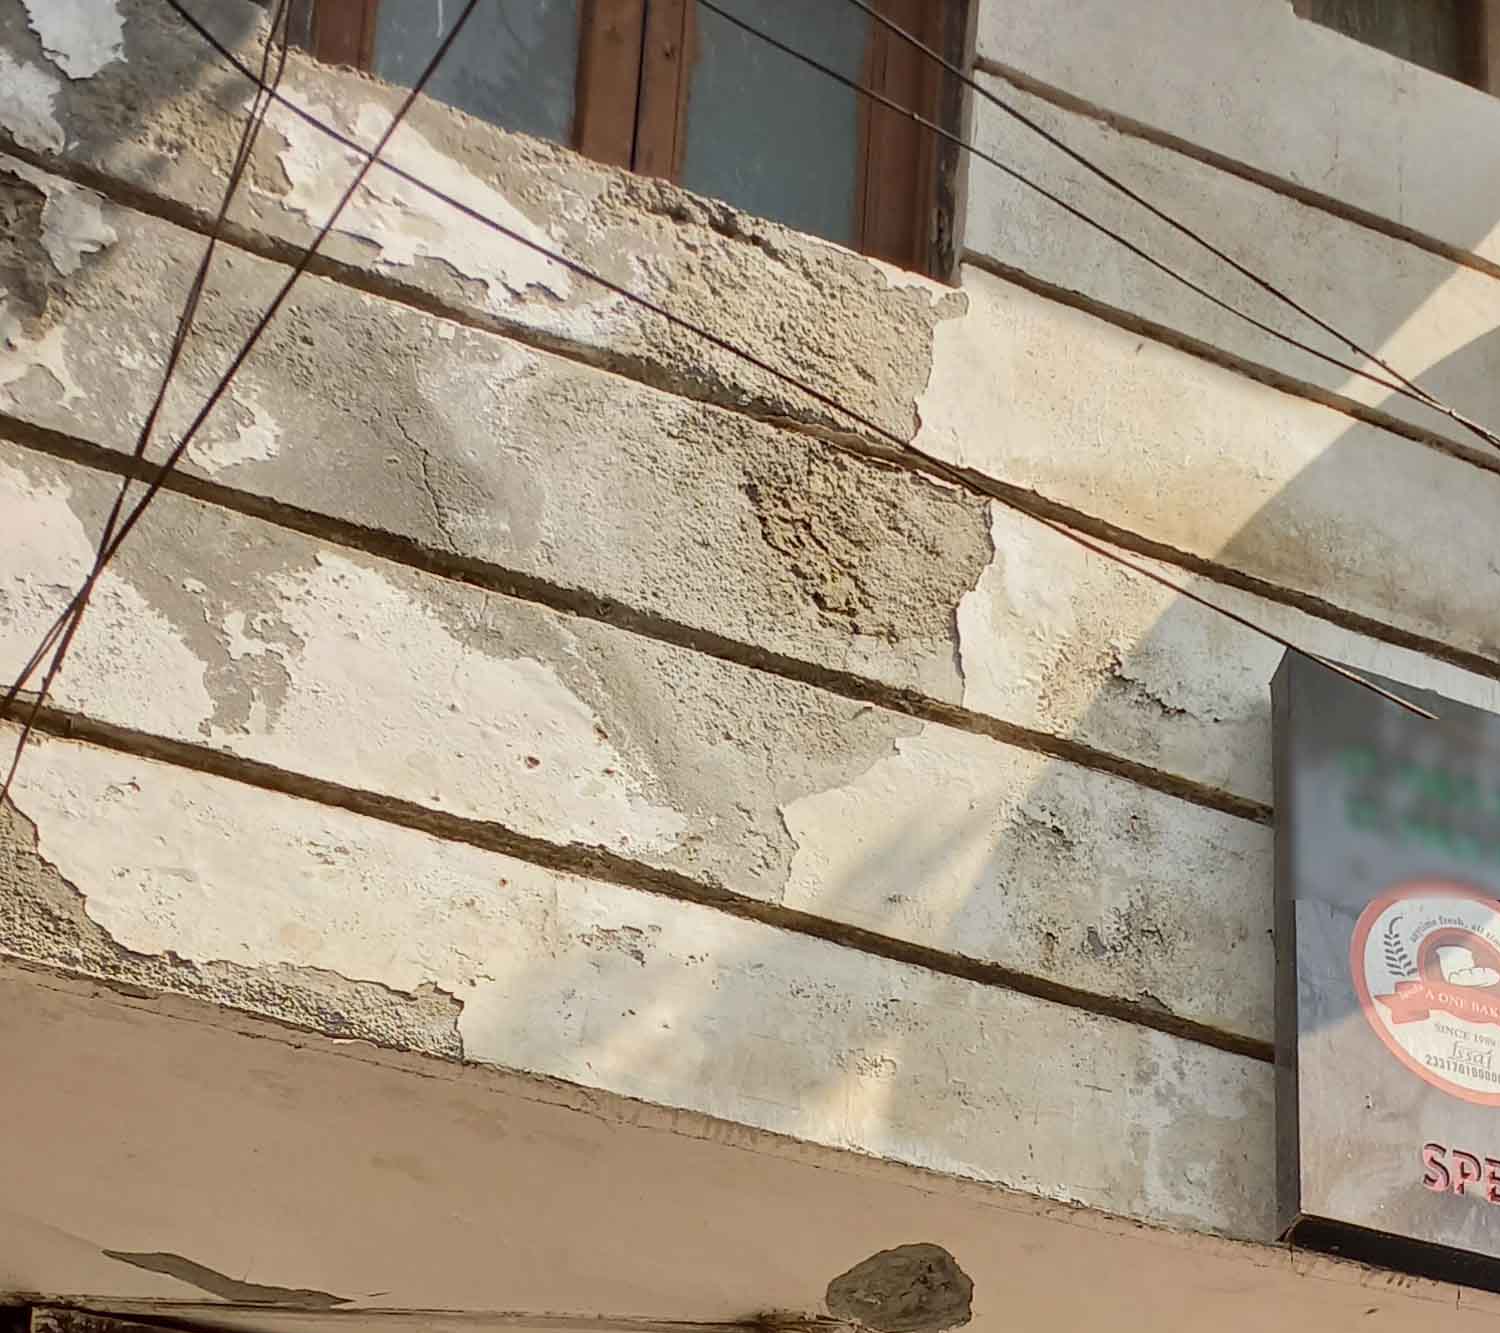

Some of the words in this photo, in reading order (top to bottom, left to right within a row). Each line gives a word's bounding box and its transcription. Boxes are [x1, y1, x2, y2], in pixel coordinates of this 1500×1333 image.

[1425, 988, 1435, 1001] A
[1438, 993, 1466, 1010] ONE
[1434, 1022, 1470, 1040] SINCE
